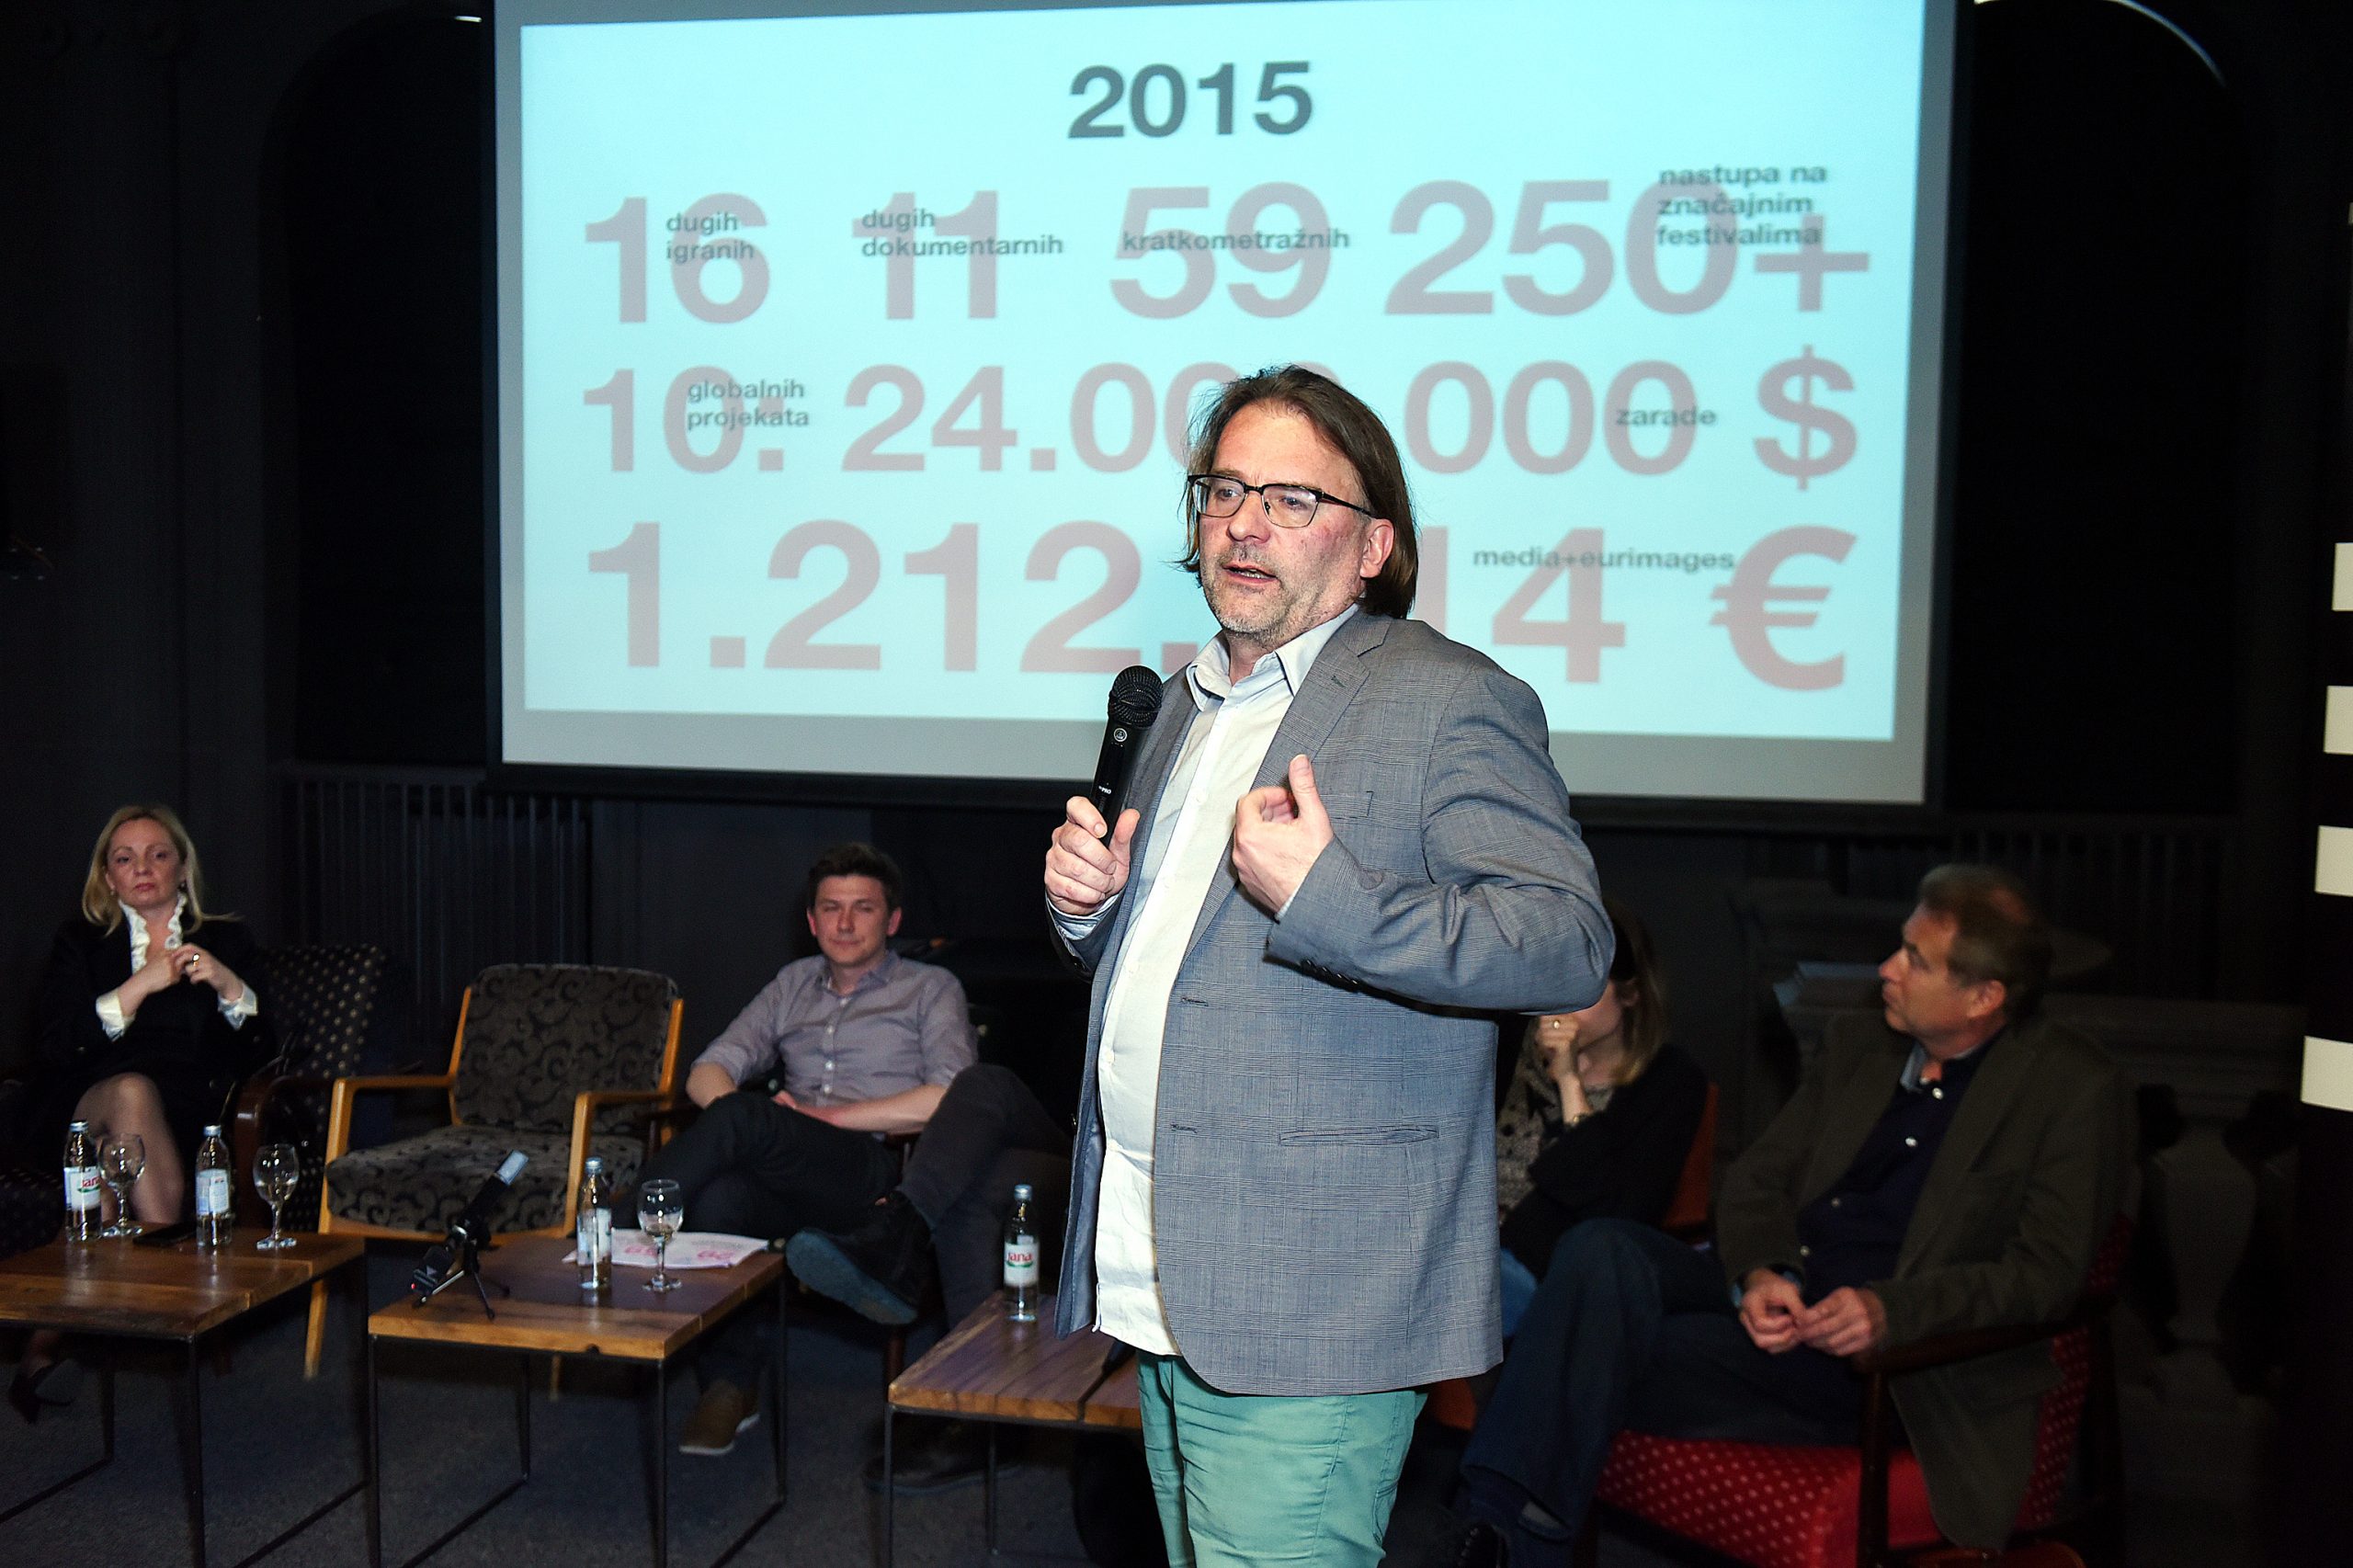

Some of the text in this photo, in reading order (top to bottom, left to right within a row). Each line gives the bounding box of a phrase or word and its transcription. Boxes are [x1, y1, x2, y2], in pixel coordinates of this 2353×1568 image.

[1068, 61, 1313, 139] 2015
[1659, 164, 1827, 187] nastupa na
[1657, 192, 1813, 218] značajnim
[665, 210, 738, 235] dugih
[861, 208, 936, 233] dugih
[861, 234, 1063, 256] dokumentarnih
[1122, 227, 1349, 251] kratkometražnih
[1657, 223, 1823, 244] festivalima
[585, 179, 1870, 324] 16 11 59 250+
[666, 240, 756, 265] igranih
[688, 379, 805, 403] globalnih
[688, 406, 809, 430] projekata
[1616, 405, 1717, 426] zarade
[1472, 545, 1734, 574] media+eurimages
